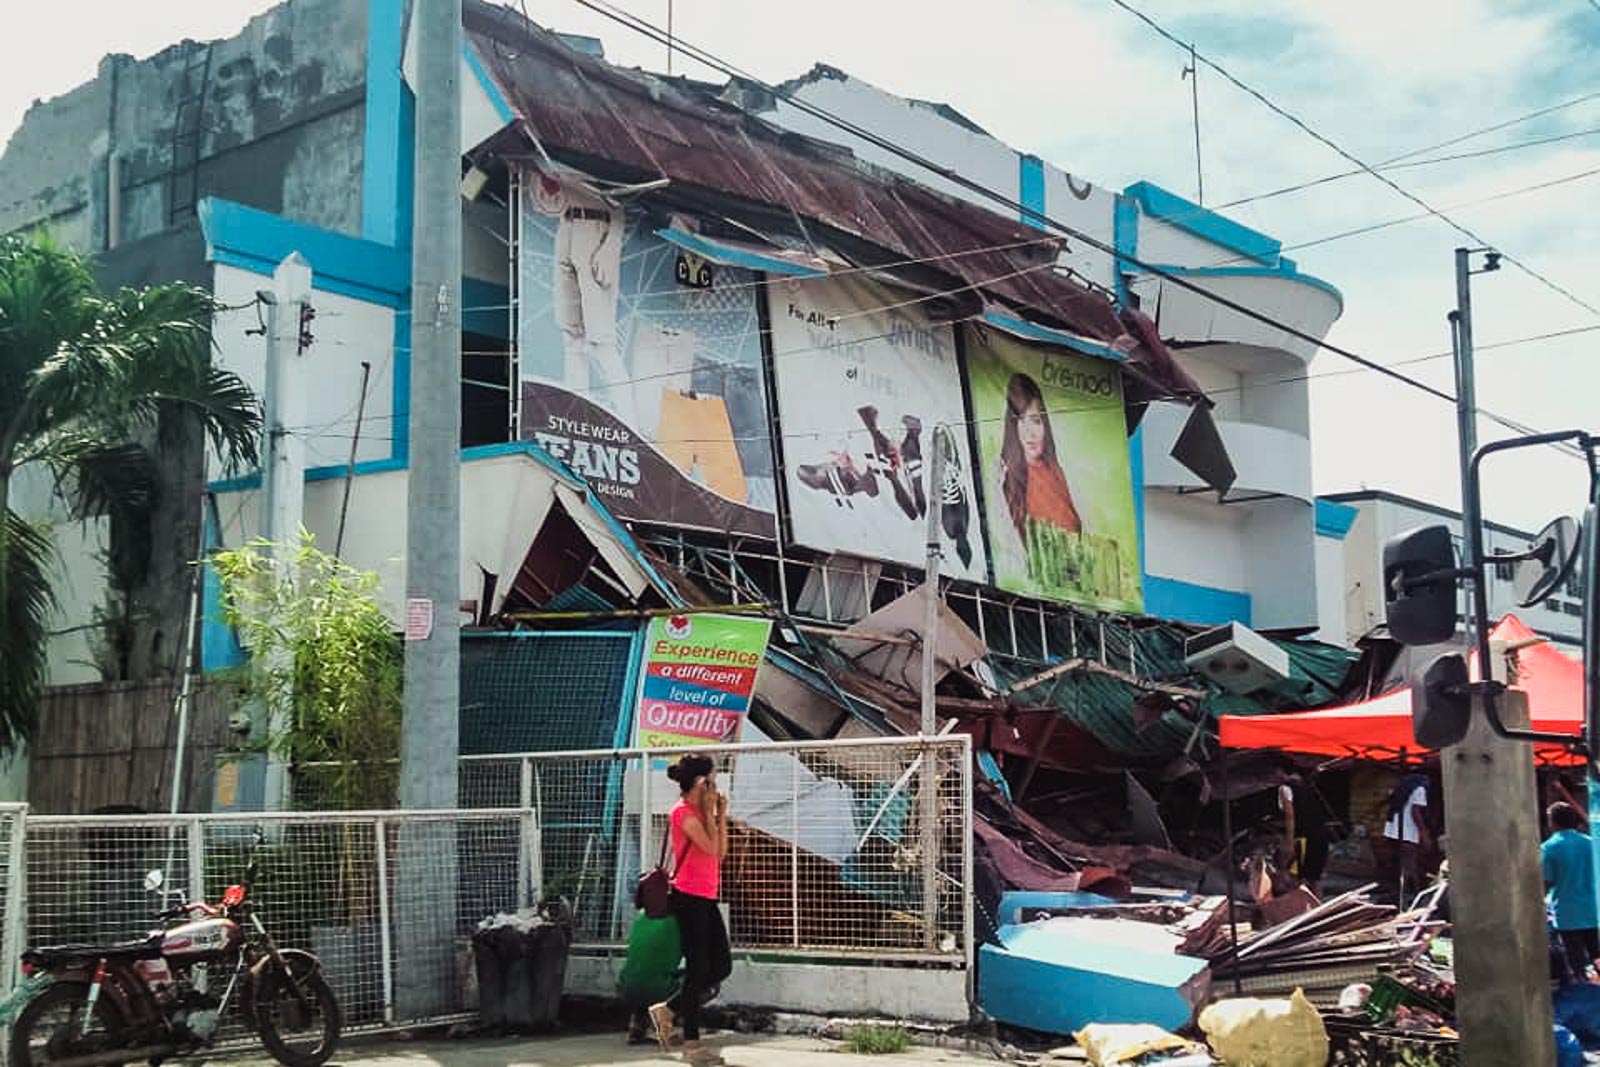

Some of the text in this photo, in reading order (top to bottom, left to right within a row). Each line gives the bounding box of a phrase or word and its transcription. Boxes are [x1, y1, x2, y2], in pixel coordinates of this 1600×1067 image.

[846, 366, 858, 381] of
[1041, 352, 1114, 397] bremod
[548, 414, 630, 445] STYLE WEAR
[654, 639, 759, 665] Experience
[660, 665, 743, 685] a different
[669, 686, 728, 707] level of
[647, 702, 737, 740] Quality
